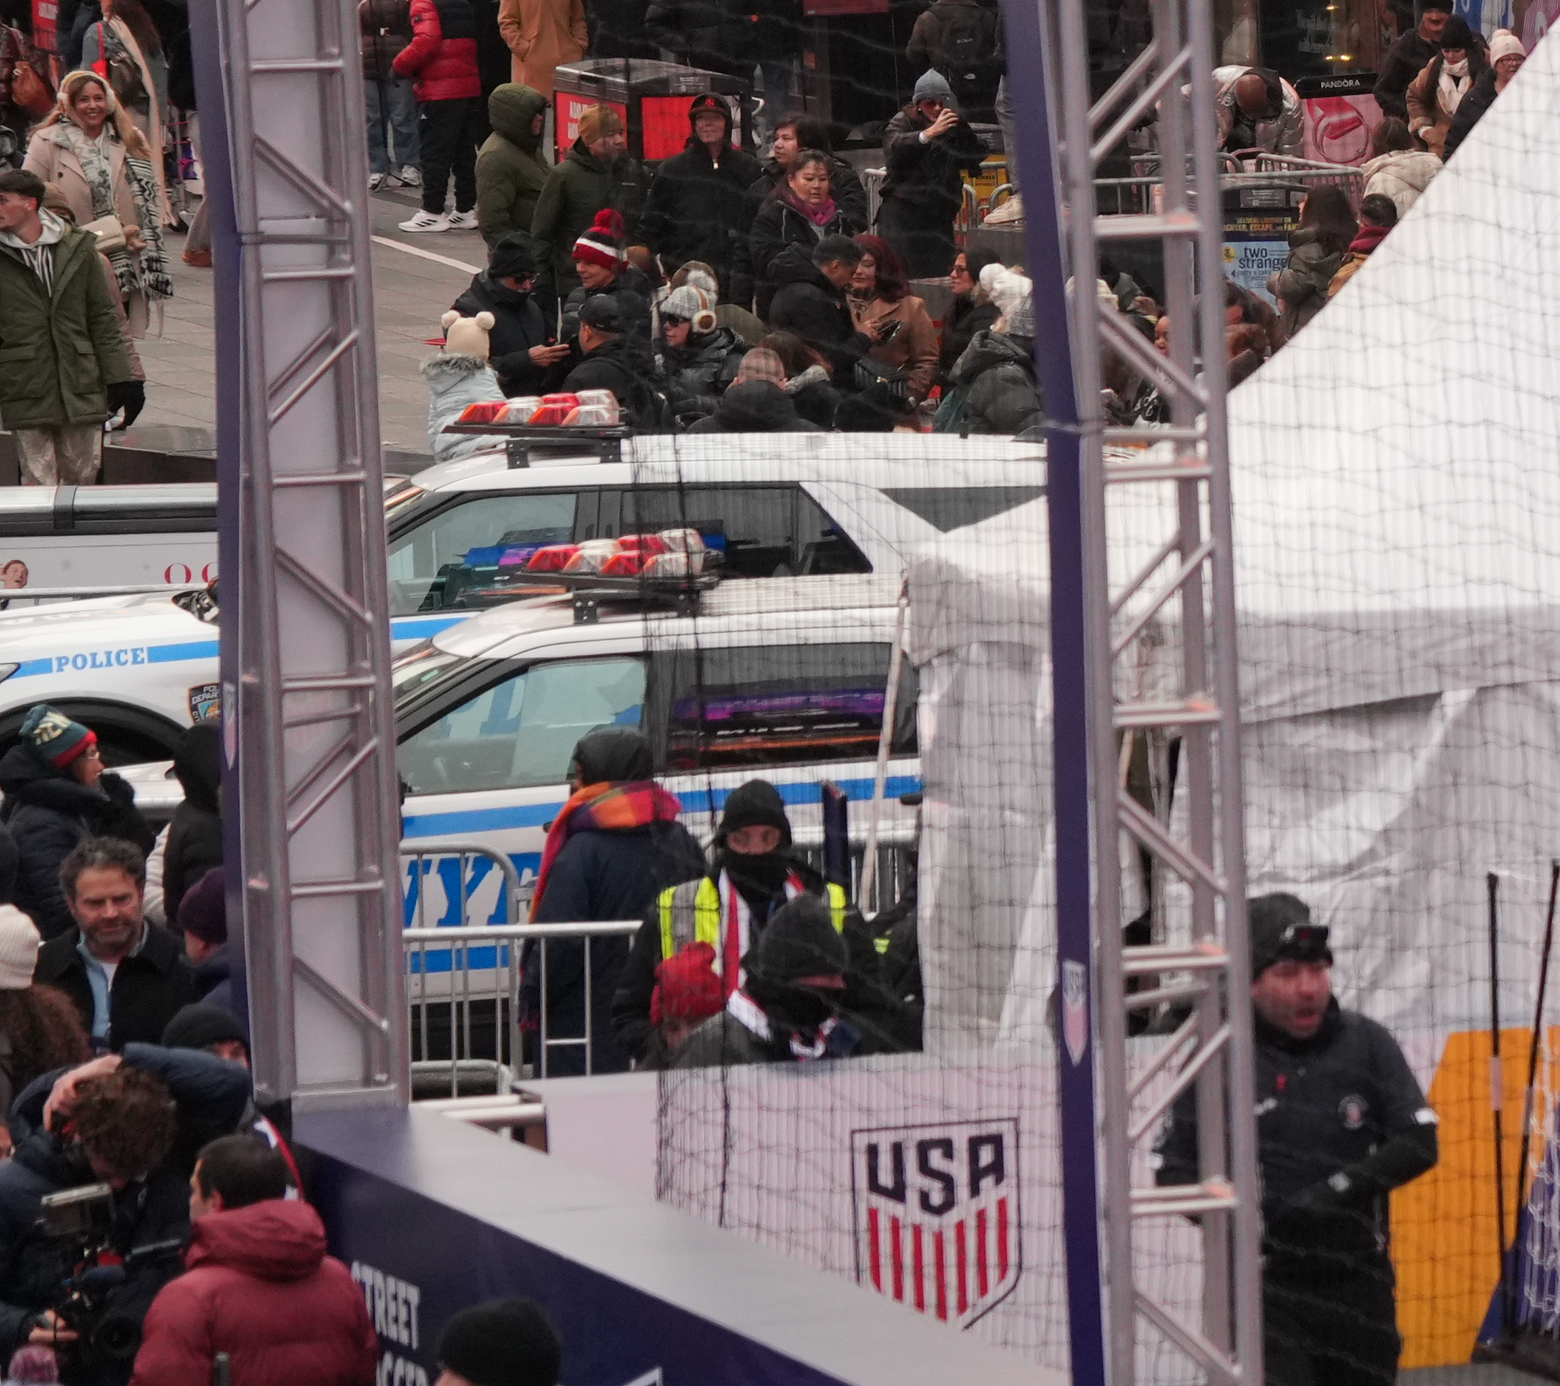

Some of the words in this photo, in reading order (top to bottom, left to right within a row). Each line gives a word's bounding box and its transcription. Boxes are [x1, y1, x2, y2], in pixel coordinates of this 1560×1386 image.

[1320, 78, 1361, 89] PANDORA
[1243, 245, 1268, 259] two
[54, 647, 146, 673] POLICE
[866, 1133, 1005, 1217] USA
